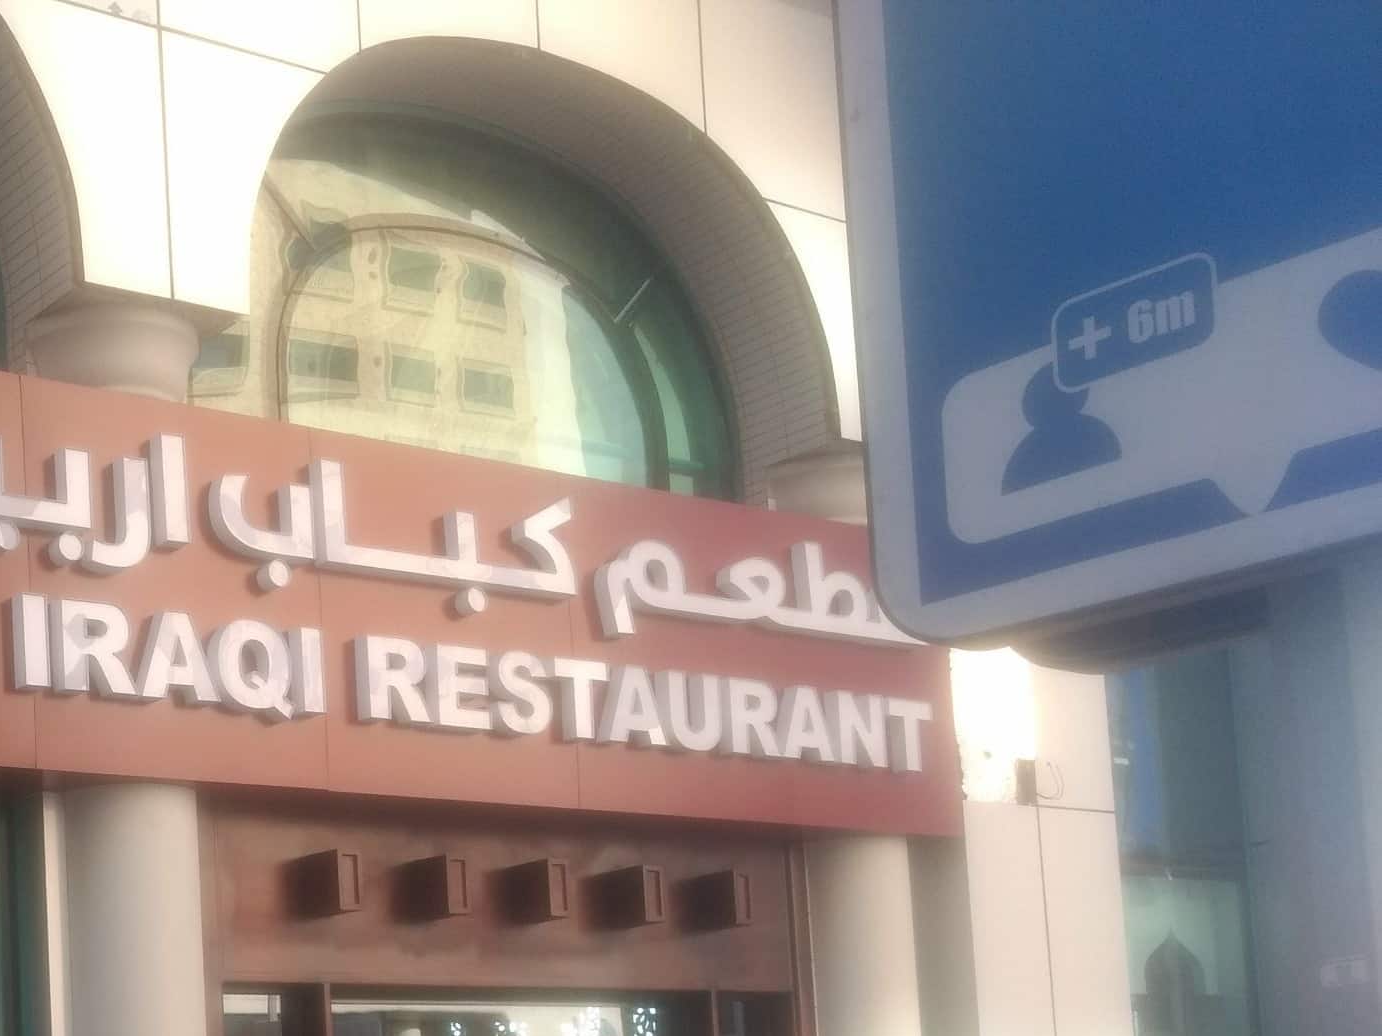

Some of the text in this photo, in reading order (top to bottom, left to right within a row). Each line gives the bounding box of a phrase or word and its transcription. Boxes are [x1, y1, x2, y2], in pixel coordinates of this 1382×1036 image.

[1128, 289, 1195, 344] 6m
[208, 458, 576, 617] كباب
[594, 538, 928, 646] طعم
[12, 591, 327, 720] IRAQI
[354, 633, 933, 773] RESTAURANT
